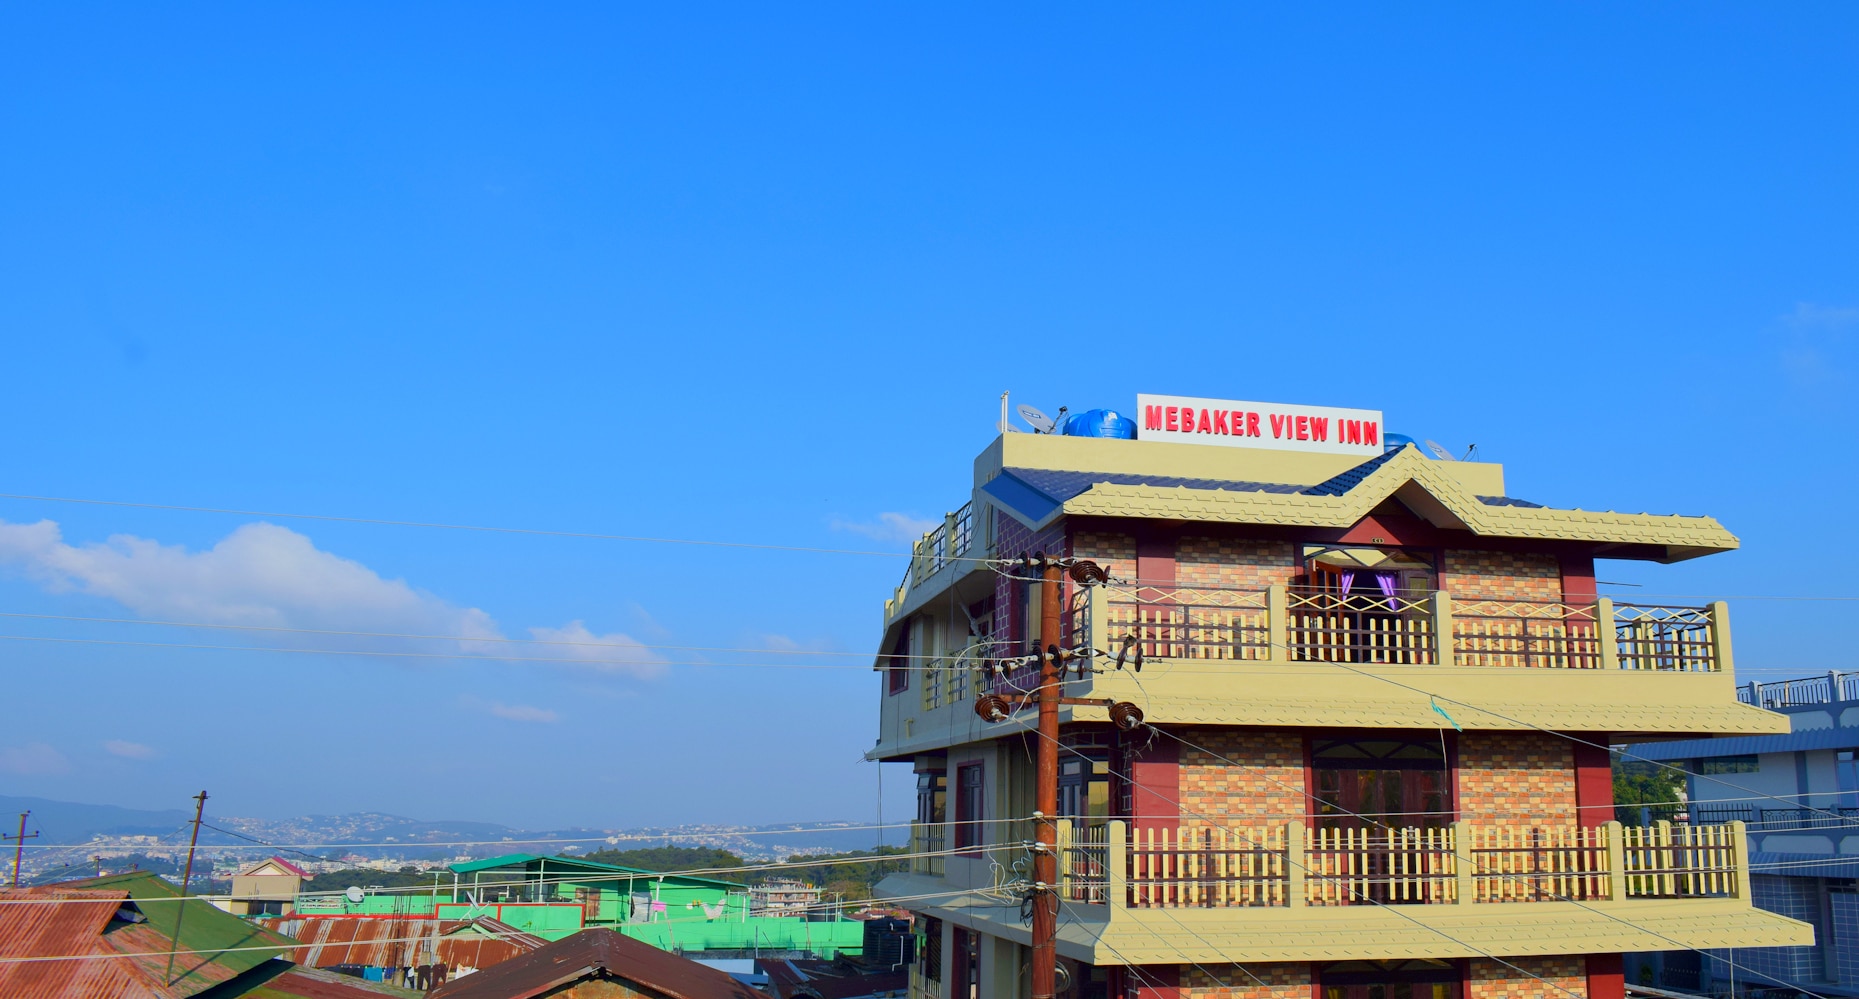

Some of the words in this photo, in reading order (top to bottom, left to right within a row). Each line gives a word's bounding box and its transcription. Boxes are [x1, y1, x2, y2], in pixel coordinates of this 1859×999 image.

[1145, 405, 1261, 437] MEBAKER
[1269, 413, 1329, 441] VIEW
[1338, 418, 1378, 446] INN
